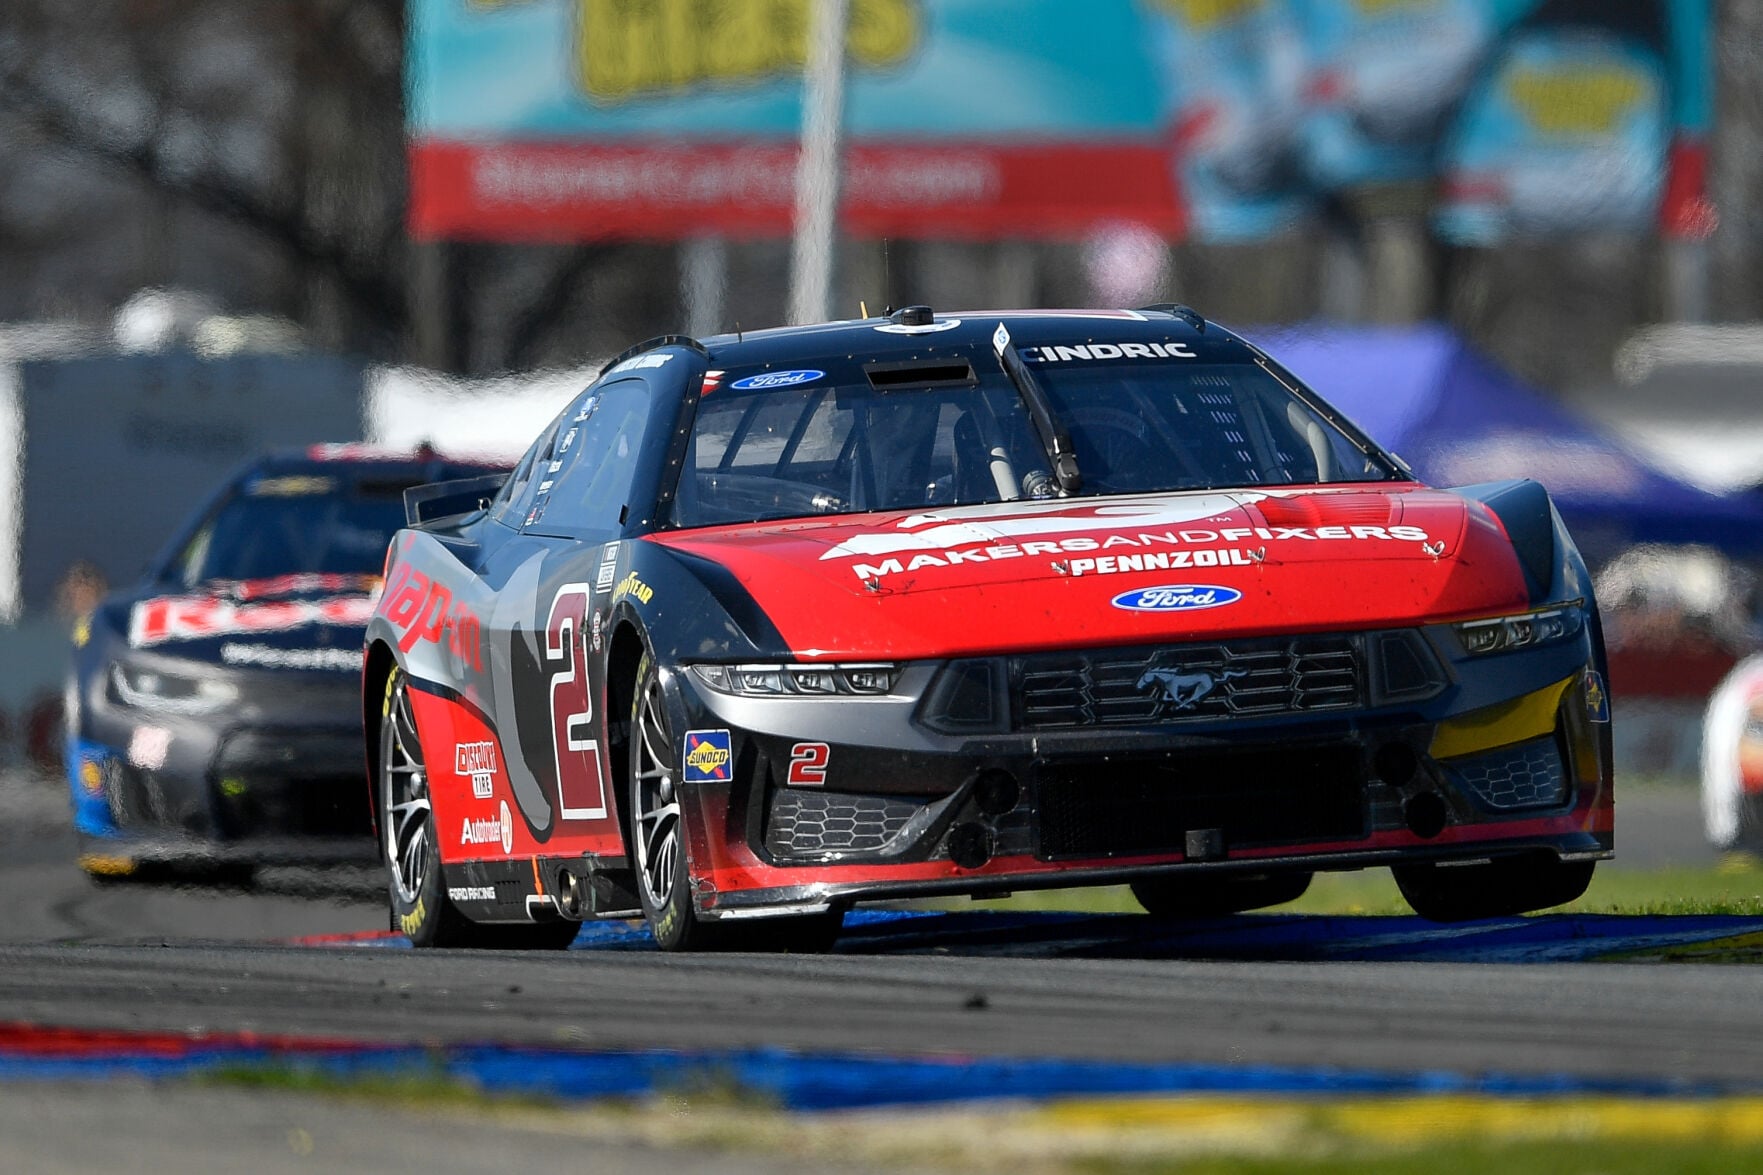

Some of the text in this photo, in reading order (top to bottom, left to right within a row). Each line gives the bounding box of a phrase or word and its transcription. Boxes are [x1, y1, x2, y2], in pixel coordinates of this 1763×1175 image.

[1020, 343, 1197, 362] CINDRIC
[745, 371, 808, 388] Ford
[1070, 549, 1251, 576] PENNZOIL
[1134, 586, 1219, 608] Ford
[545, 583, 608, 820] 2
[455, 741, 497, 775] DISCOUNT
[689, 750, 727, 765] SUNOCO
[787, 742, 830, 786] 2
[474, 776, 492, 794] TIRE
[461, 815, 501, 845] Autotrader
[448, 886, 497, 901] FORD RACING
